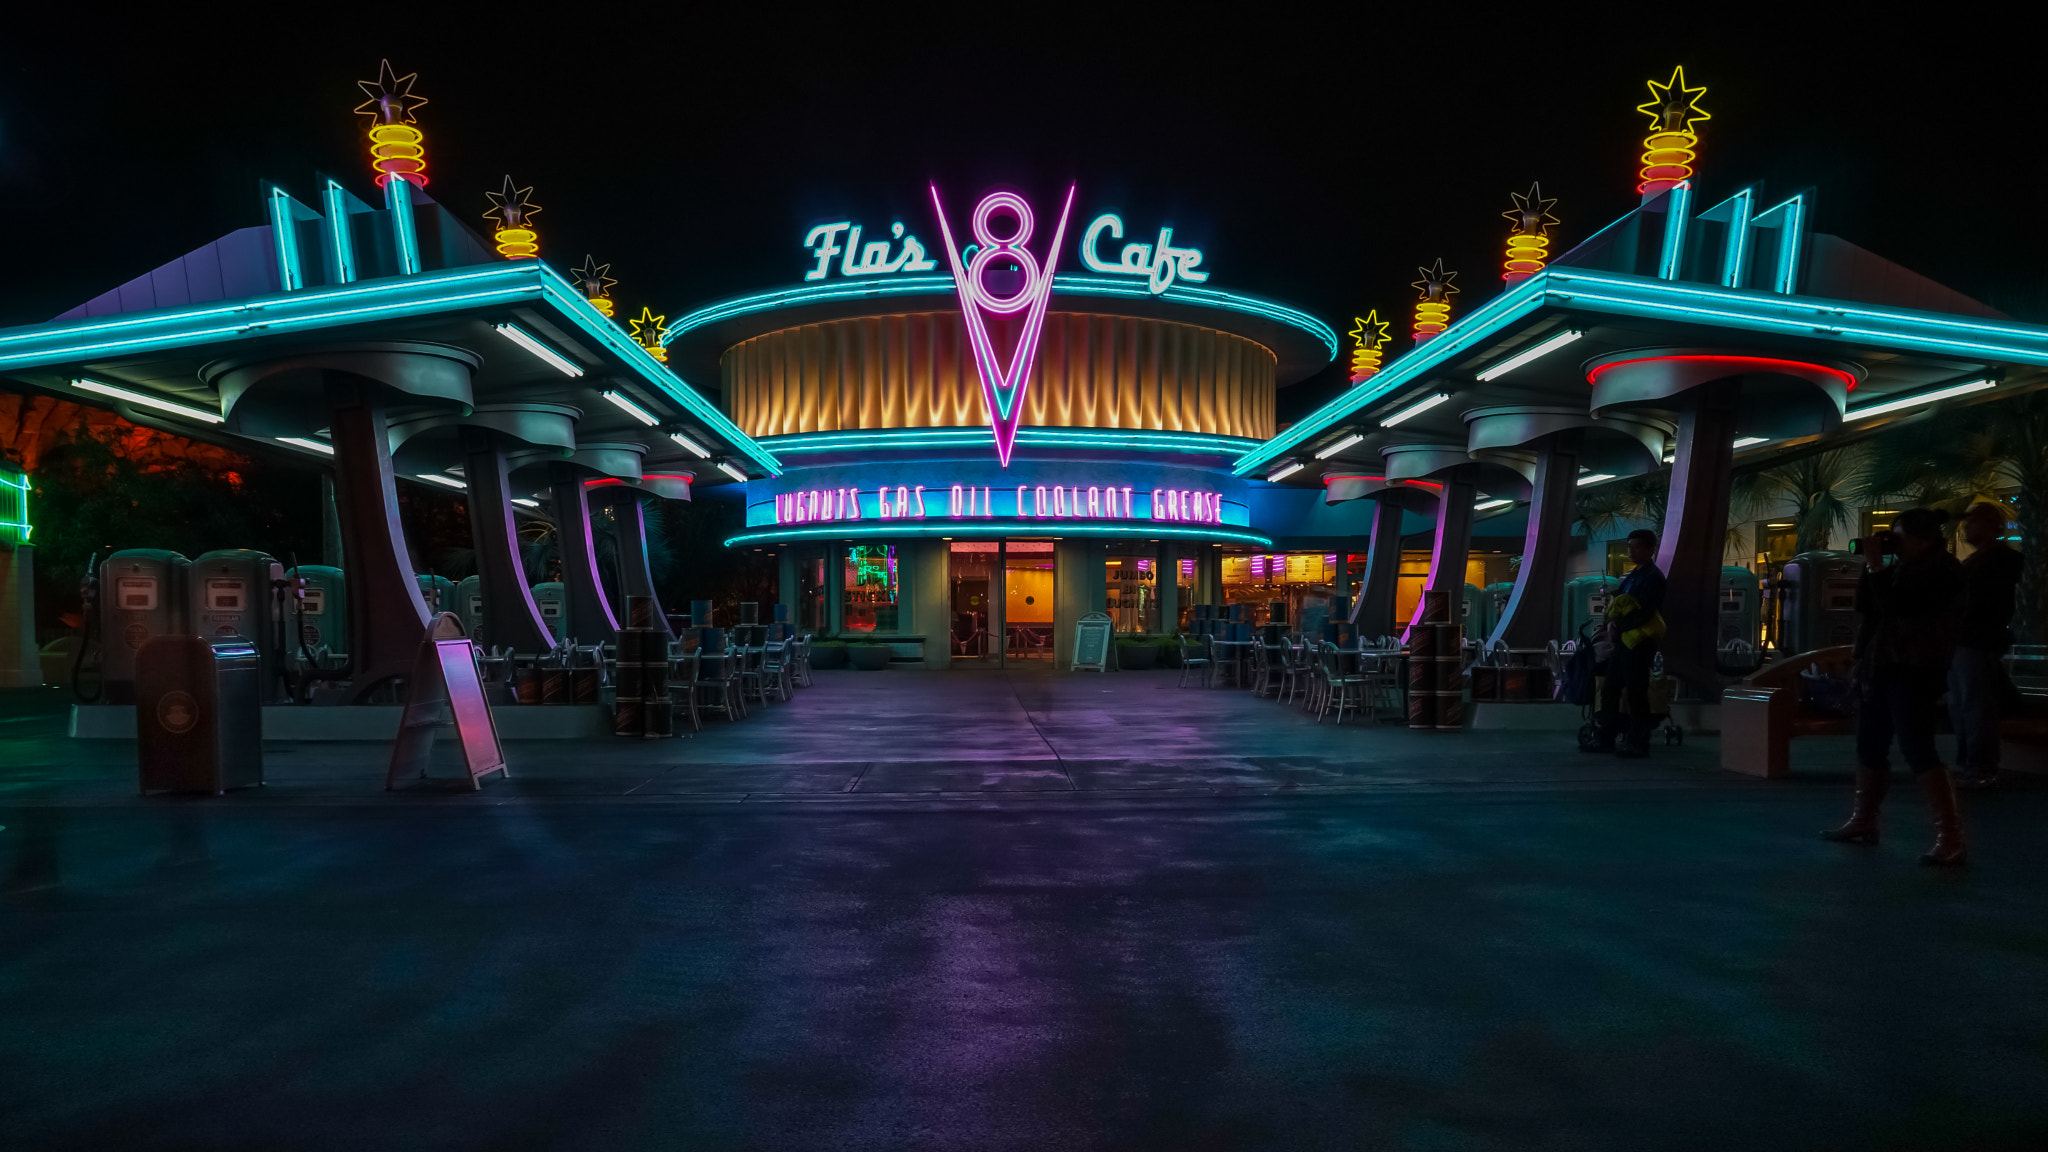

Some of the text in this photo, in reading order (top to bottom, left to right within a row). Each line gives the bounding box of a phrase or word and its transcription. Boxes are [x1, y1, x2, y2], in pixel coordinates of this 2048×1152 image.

[804, 221, 938, 281] Flo's
[1082, 213, 1210, 294] Cafe
[879, 486, 926, 519] GAS
[952, 485, 993, 517] OIL
[1017, 485, 1132, 518] COOLANT
[1152, 489, 1223, 523] GREASE
[1112, 570, 1154, 580] JUMBO
